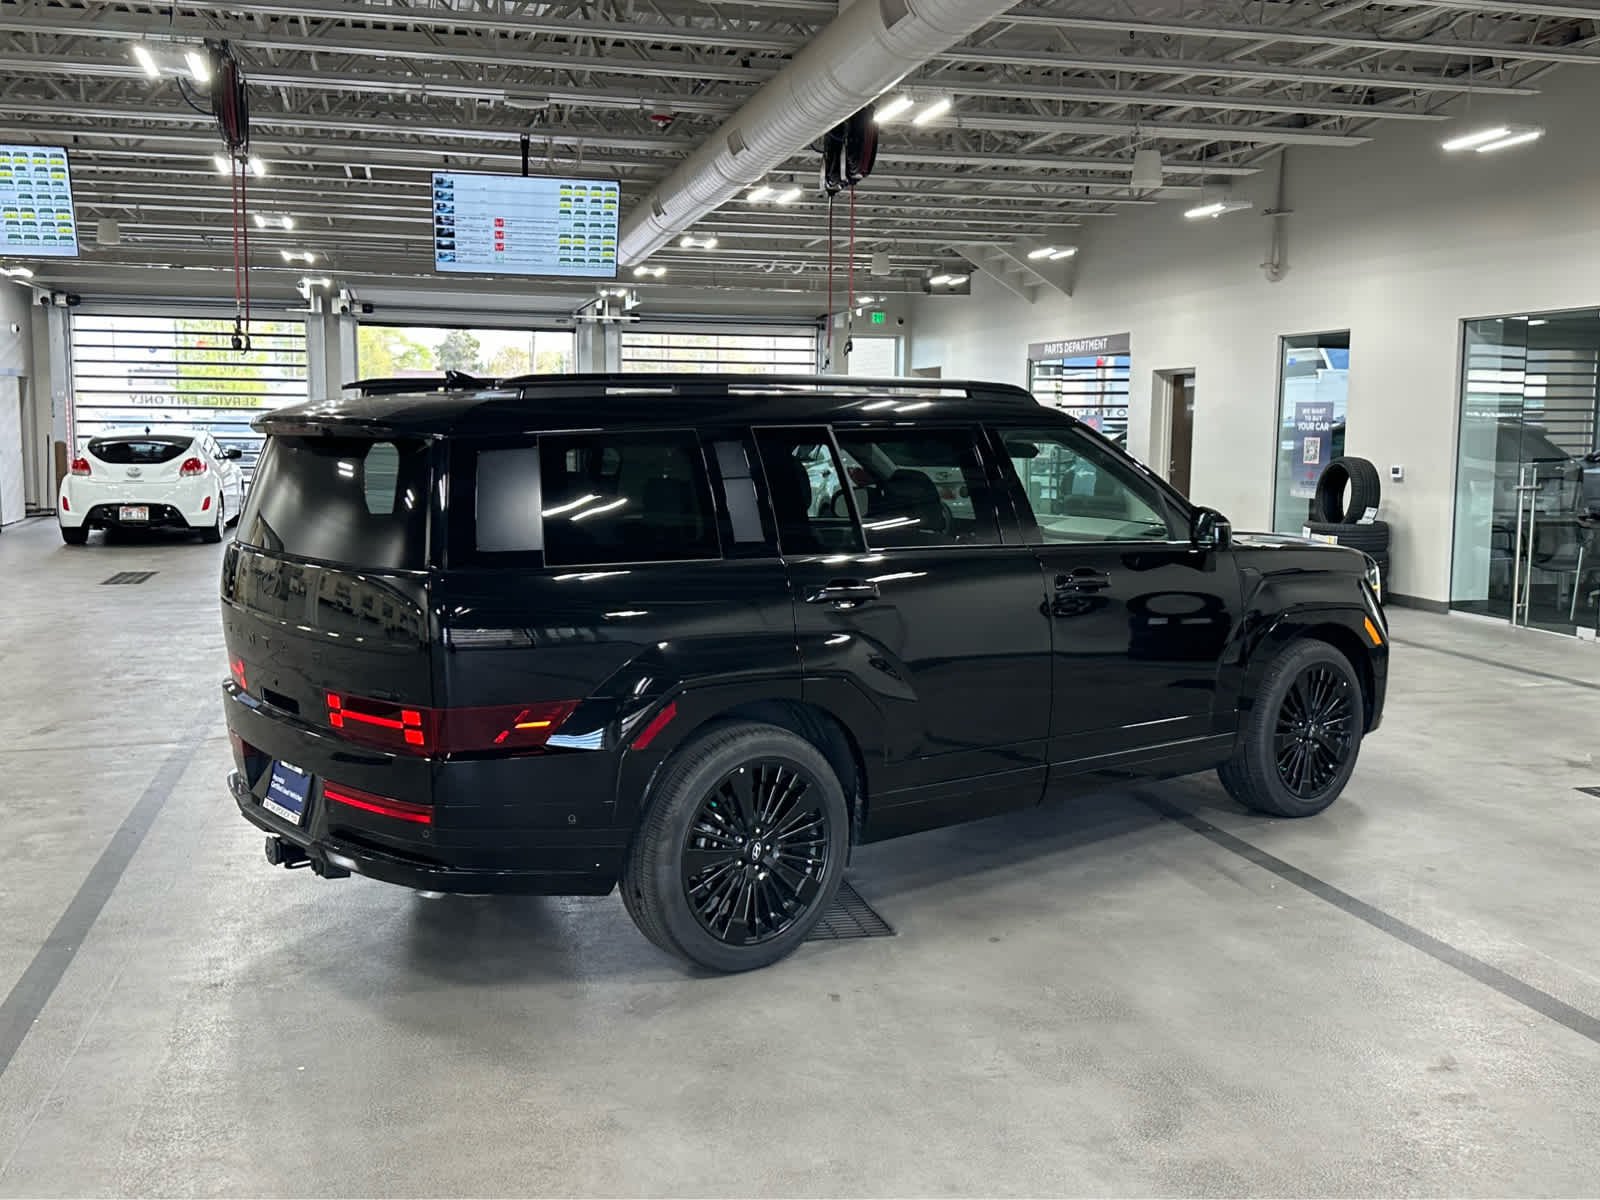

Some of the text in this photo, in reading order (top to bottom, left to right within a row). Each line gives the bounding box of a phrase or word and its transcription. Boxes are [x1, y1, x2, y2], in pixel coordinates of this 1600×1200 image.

[1044, 338, 1108, 354] PARTS DEPARTMENT
[1297, 422, 1329, 431] YOUR CAR
